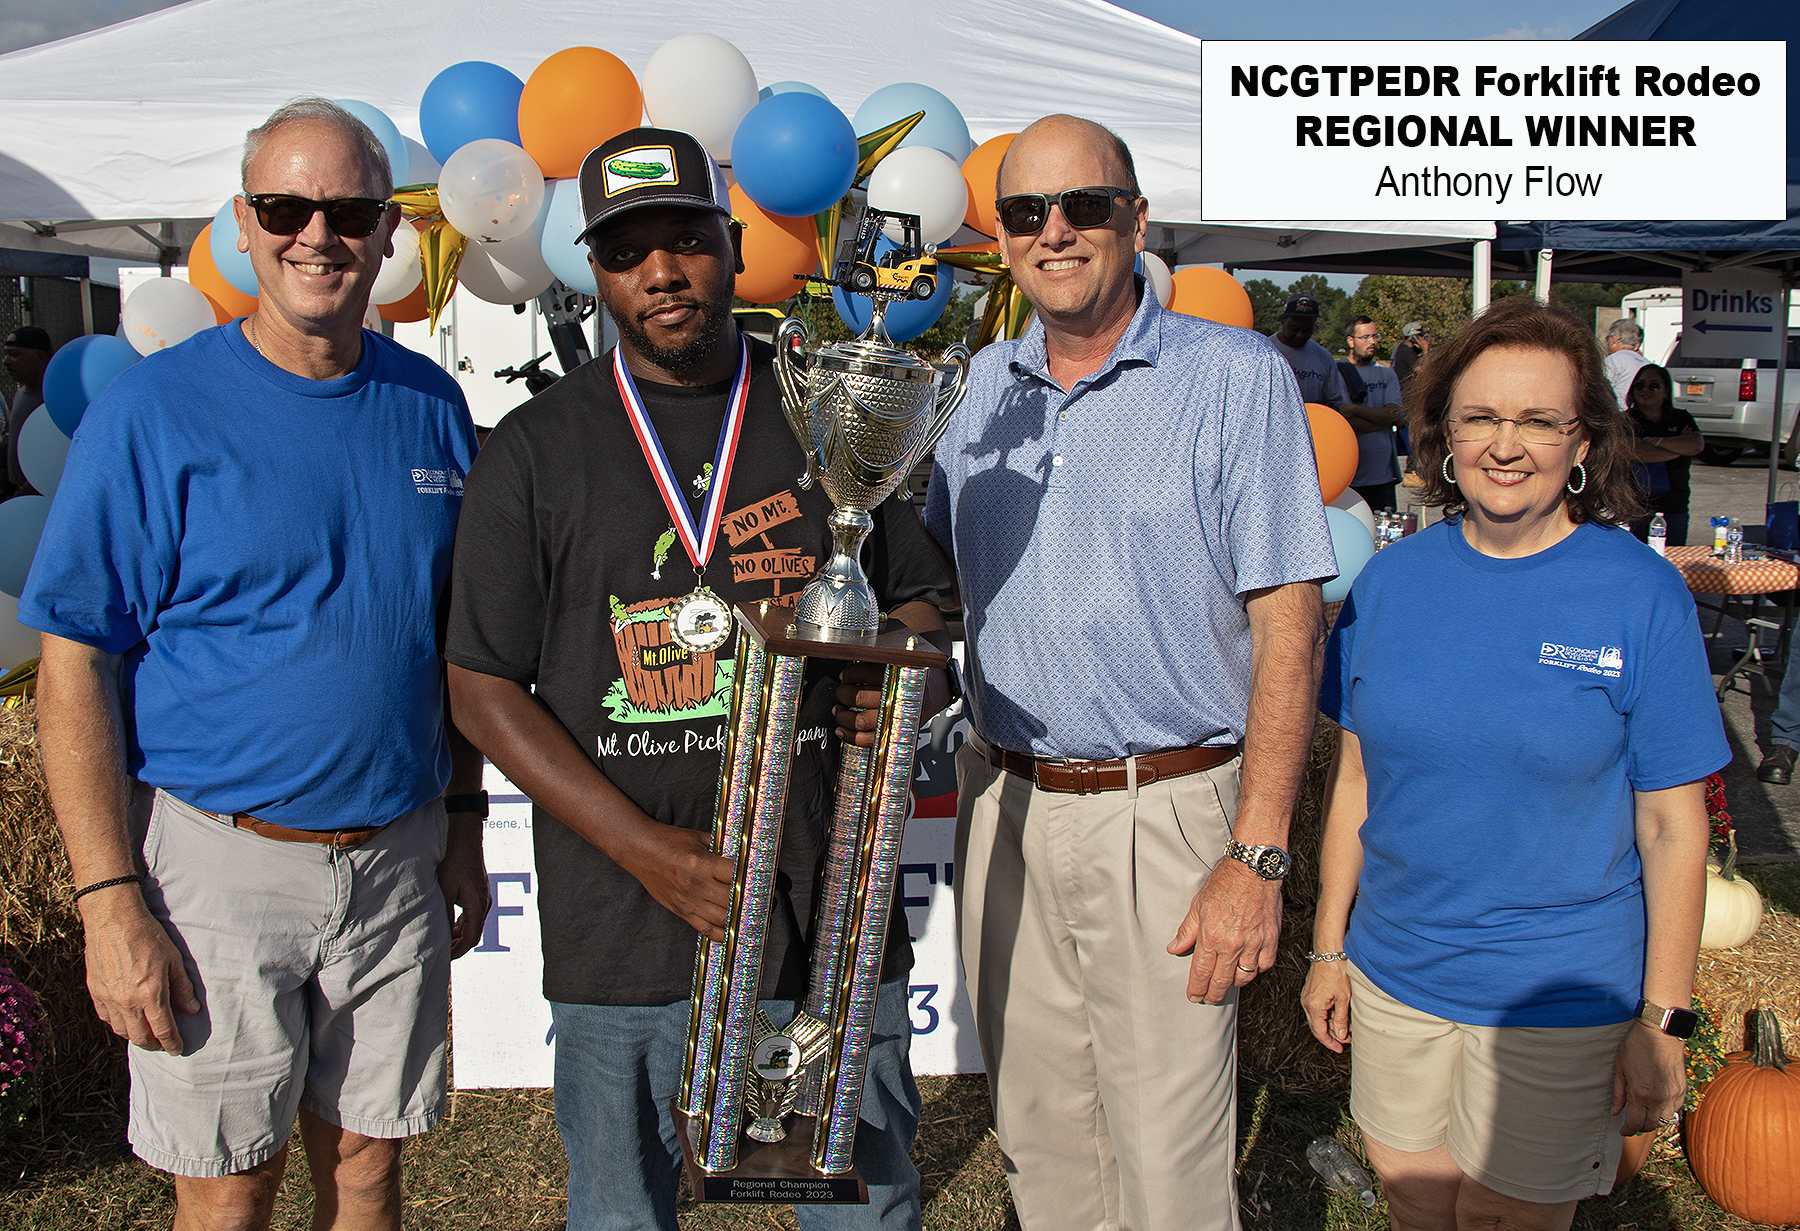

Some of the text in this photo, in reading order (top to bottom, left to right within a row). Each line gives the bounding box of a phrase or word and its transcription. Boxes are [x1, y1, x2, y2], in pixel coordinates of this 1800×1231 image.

[1692, 289, 1773, 314] Drinks
[732, 499, 791, 537] NO Mt.
[734, 557, 809, 576] NO OLIVES
[643, 646, 688, 666] Mt. Olive
[1538, 658, 1621, 678] FORKLIFT Rodeo 2023
[597, 724, 828, 757] Mt. Olive Pick pany
[484, 820, 521, 829] reene,
[730, 1190, 834, 1199] Forklift Rodeo 2023
[733, 1180, 830, 1189] Regional Champion
